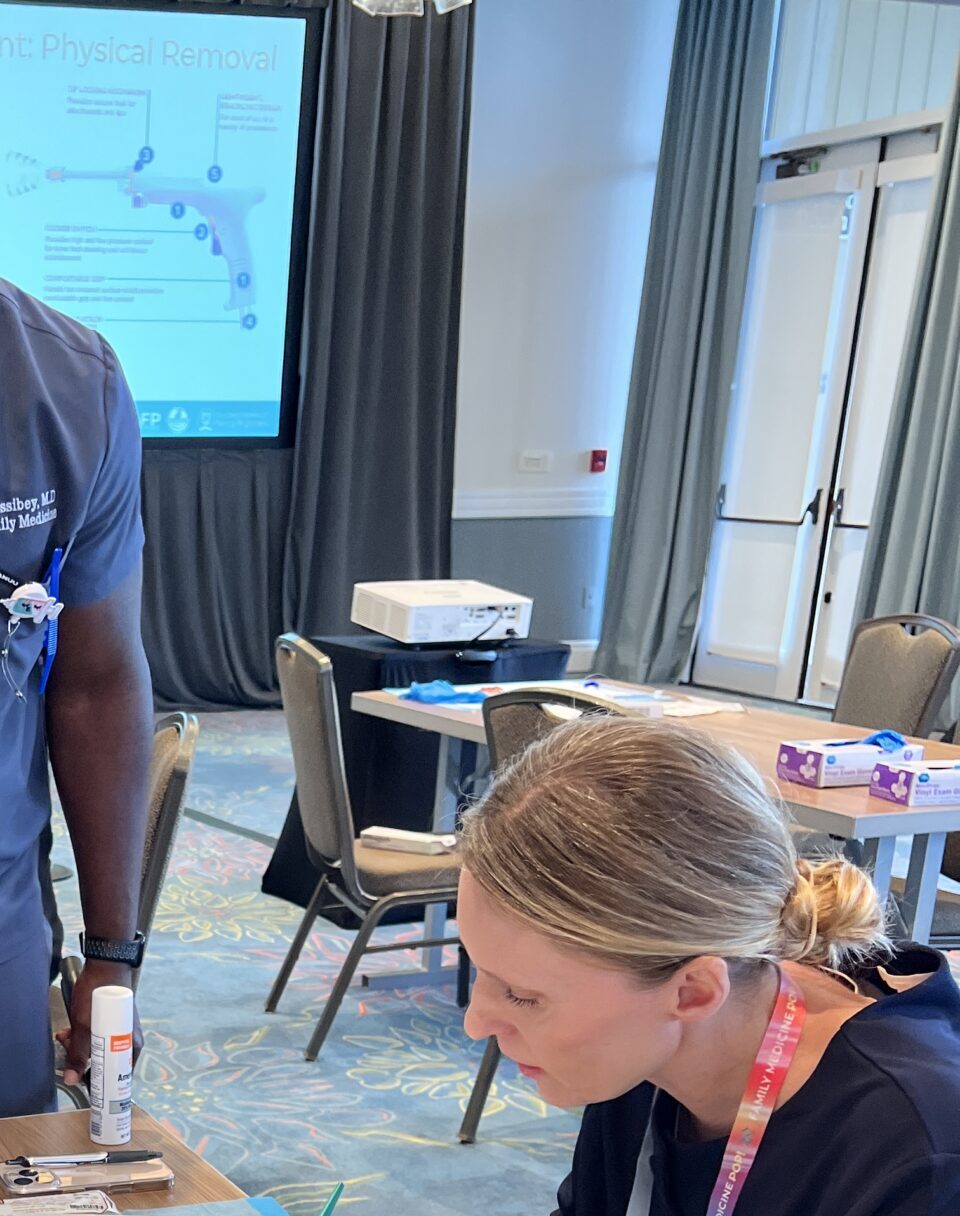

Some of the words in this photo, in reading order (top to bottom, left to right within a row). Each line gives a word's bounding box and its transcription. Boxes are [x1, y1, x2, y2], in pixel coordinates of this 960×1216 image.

[41, 32, 153, 67] Physical
[161, 40, 277, 72] Removal
[748, 1075, 773, 1122] FAMILY
[765, 1011, 795, 1075] MEDICINE
